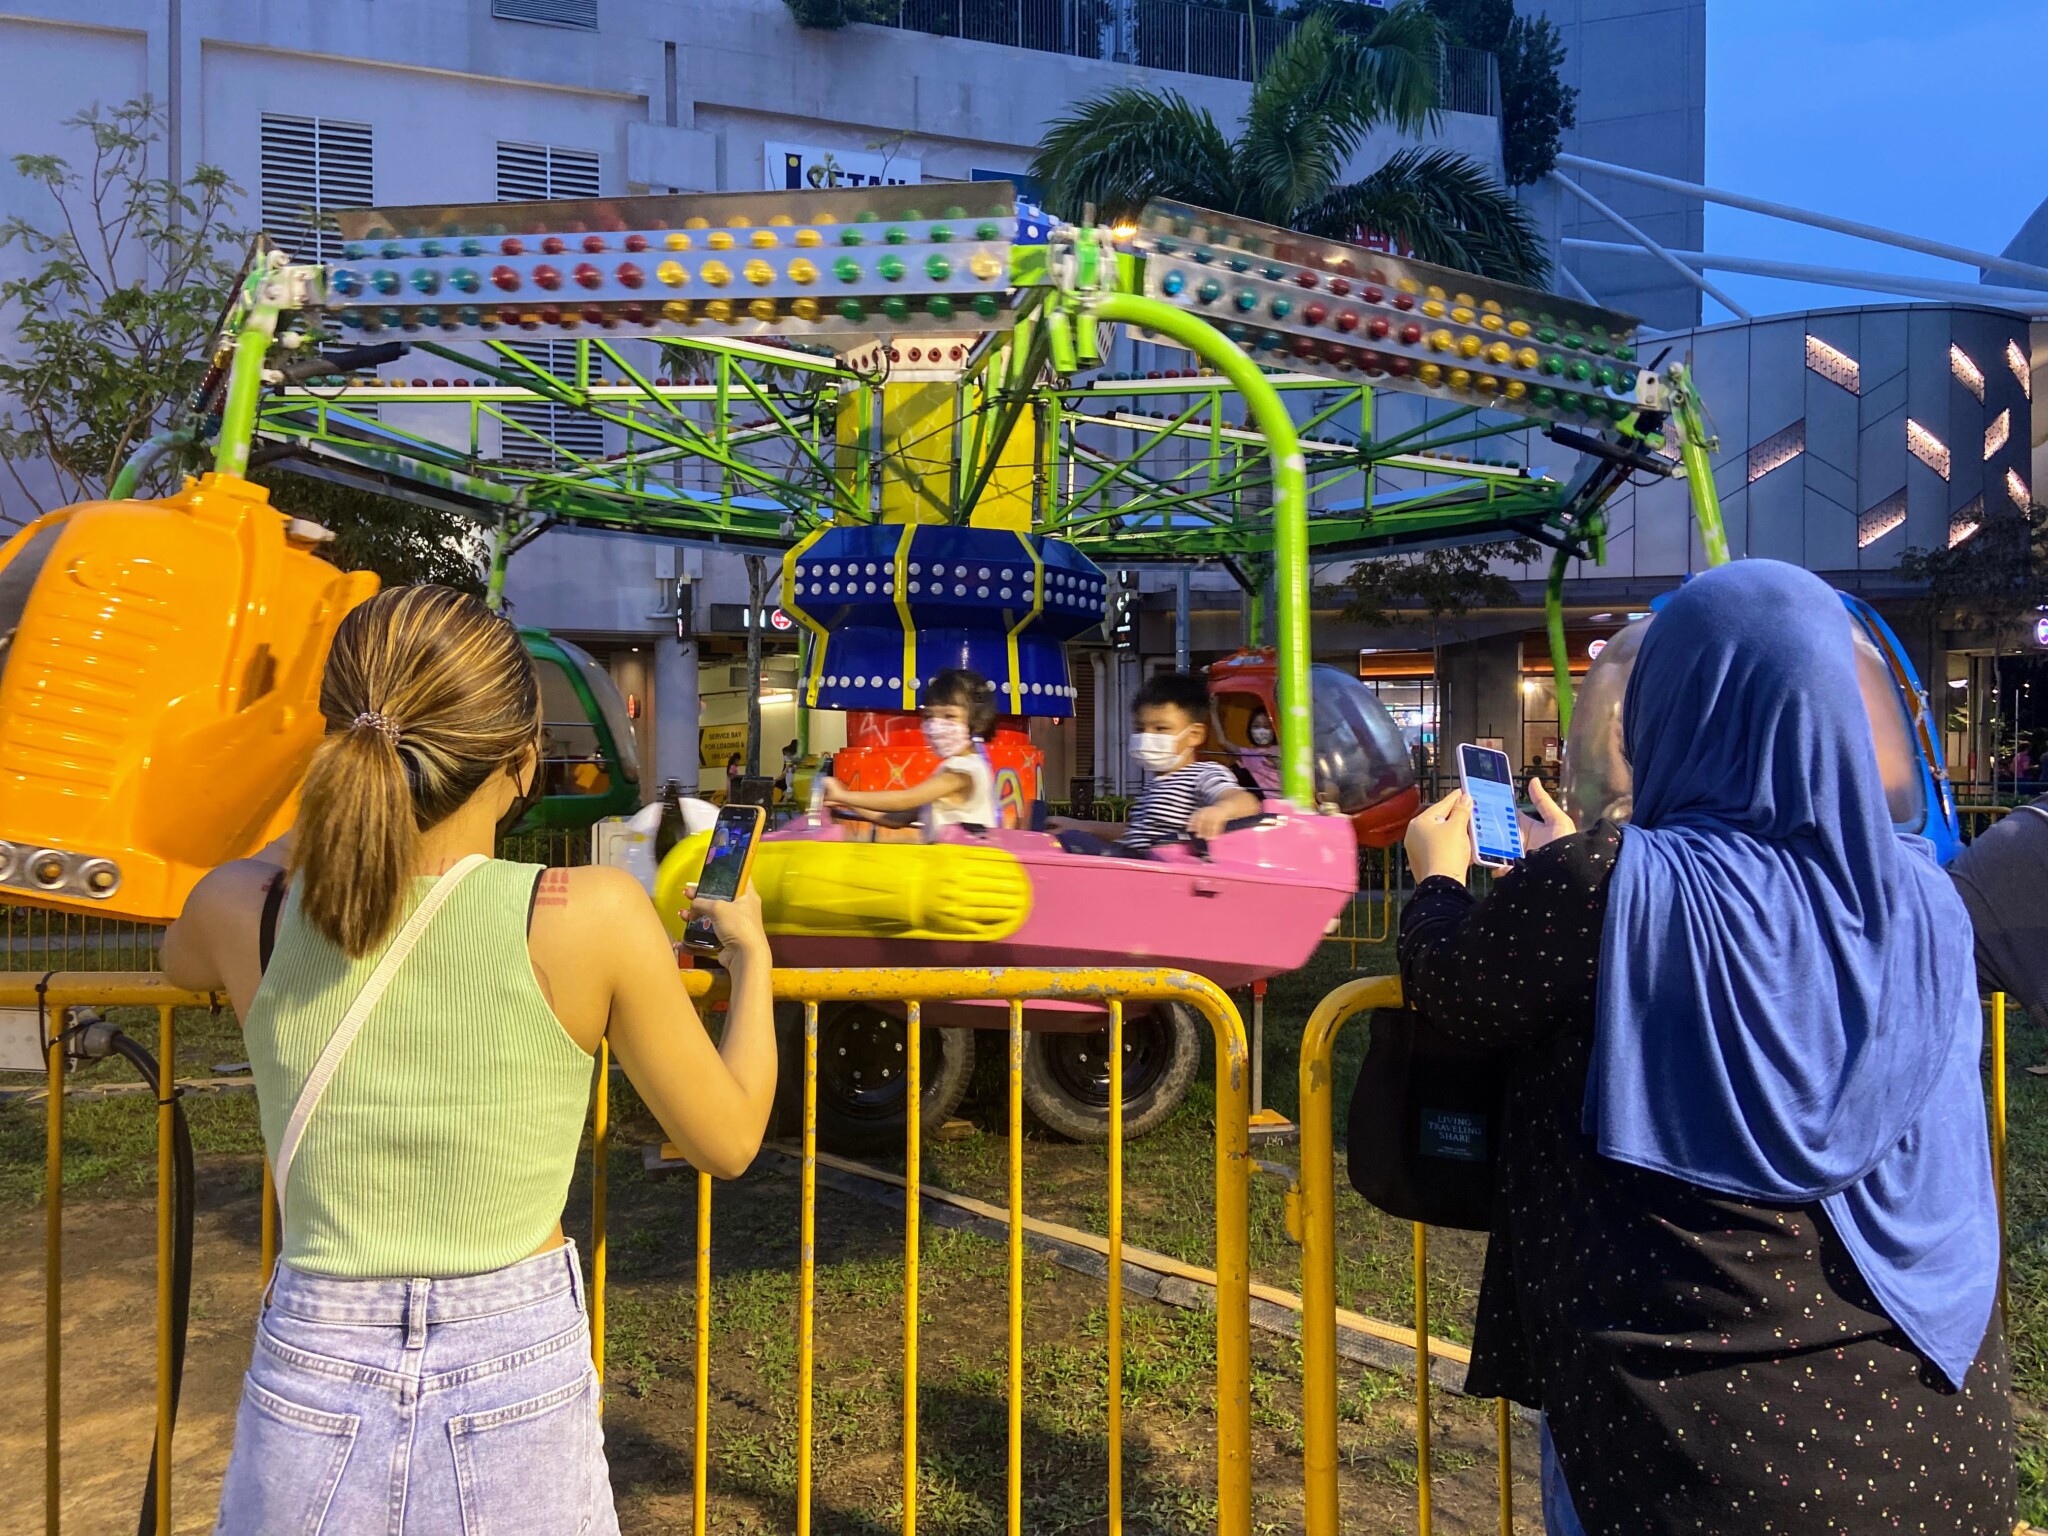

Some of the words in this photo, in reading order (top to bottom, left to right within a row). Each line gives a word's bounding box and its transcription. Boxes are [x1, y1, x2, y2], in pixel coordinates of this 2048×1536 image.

[709, 732, 730, 740] SERVICE
[717, 742, 740, 750] LOADING
[1437, 1115, 1472, 1126] LIVING
[1427, 1121, 1482, 1135] TRAVELING
[1438, 1131, 1471, 1143] SHARE
